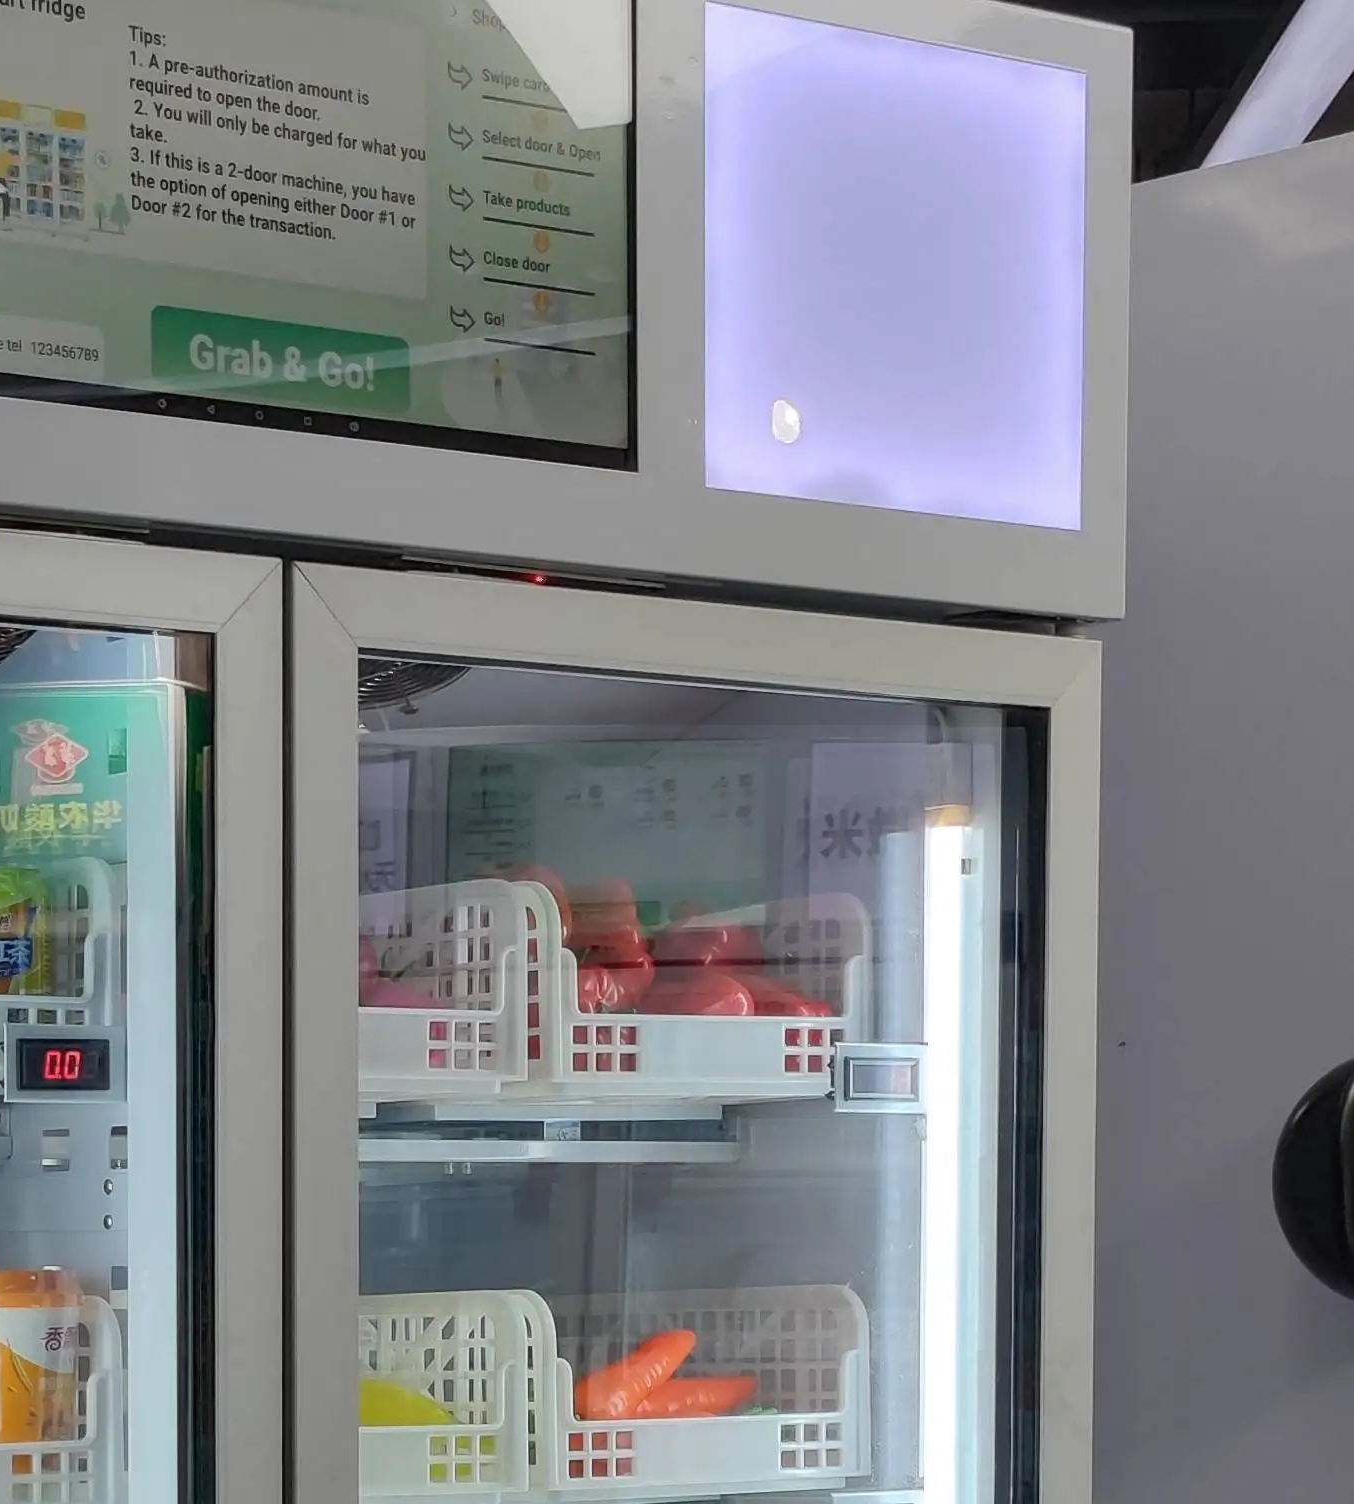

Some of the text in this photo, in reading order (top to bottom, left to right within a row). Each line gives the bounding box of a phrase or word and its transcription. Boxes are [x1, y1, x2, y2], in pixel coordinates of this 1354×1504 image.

[128, 24, 166, 48] Tips:
[129, 50, 370, 106] 1. A pre-authorization amount is
[482, 68, 519, 89] Swipe
[129, 75, 321, 122] required to open the door.
[130, 123, 168, 145] take.
[133, 99, 426, 163] 2. You will only be charged for what you
[482, 129, 601, 163] Select door & Open
[130, 146, 416, 207] 3. If this is a 2-door machine, you have
[130, 171, 416, 230] the option of opening either Door #1 or
[482, 190, 571, 218] Take products
[131, 195, 337, 241] Door #2 for the transaction.
[483, 251, 551, 275] Close door
[484, 311, 505, 328] Go!
[6, 338, 22, 353] tel
[30, 342, 100, 363] 123456789
[189, 333, 375, 392] Grab & Go!
